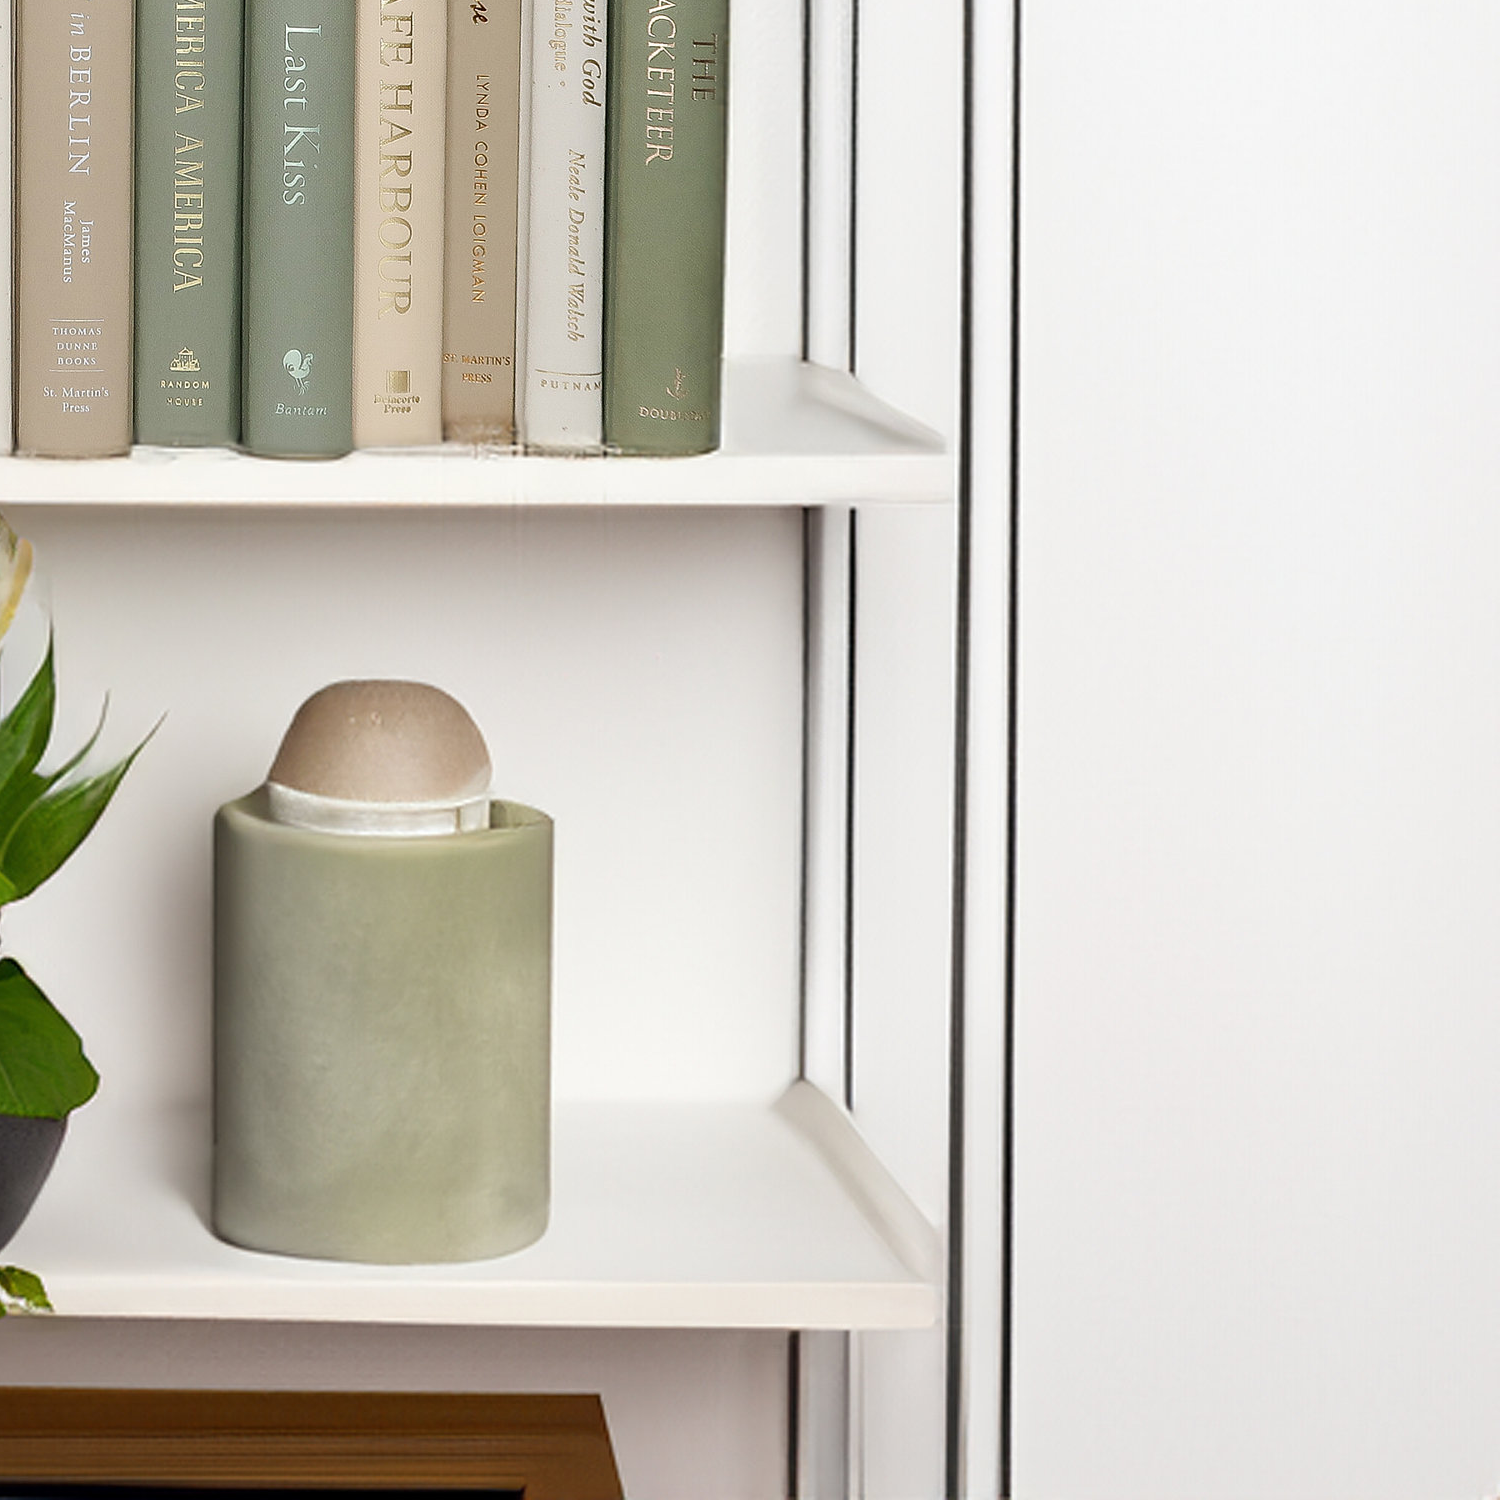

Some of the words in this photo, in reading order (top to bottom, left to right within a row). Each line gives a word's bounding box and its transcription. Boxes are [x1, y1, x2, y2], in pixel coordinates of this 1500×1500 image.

[69, 11, 87, 37] in
[283, 23, 322, 111] Last
[581, 58, 602, 108] God
[690, 33, 719, 102] THE
[67, 45, 93, 176] BERLIN
[474, 74, 490, 132] LYNDA
[282, 122, 321, 206] Kiss
[472, 141, 489, 206] COHEN
[567, 148, 588, 201] Neale
[172, 131, 204, 294] AMERICA
[376, 80, 416, 320] HARBOUR
[63, 200, 77, 284] MacManus
[80, 220, 95, 264] James
[471, 214, 488, 304] LOIGMAN
[566, 207, 587, 275] Donald
[52, 326, 102, 336] THOMAS
[566, 282, 587, 342] Walsch
[56, 341, 98, 351] DUNNE
[57, 356, 97, 366] BOOKS
[461, 354, 511, 366] MARTIN'S
[42, 386, 58, 398] St.
[62, 386, 109, 398] Martin's
[160, 380, 211, 390] RANDOM
[166, 397, 204, 407] HOUSE
[462, 373, 493, 384] PRESS
[62, 402, 90, 413] Press
[275, 403, 328, 417] Bantam
[383, 404, 412, 415] Press
